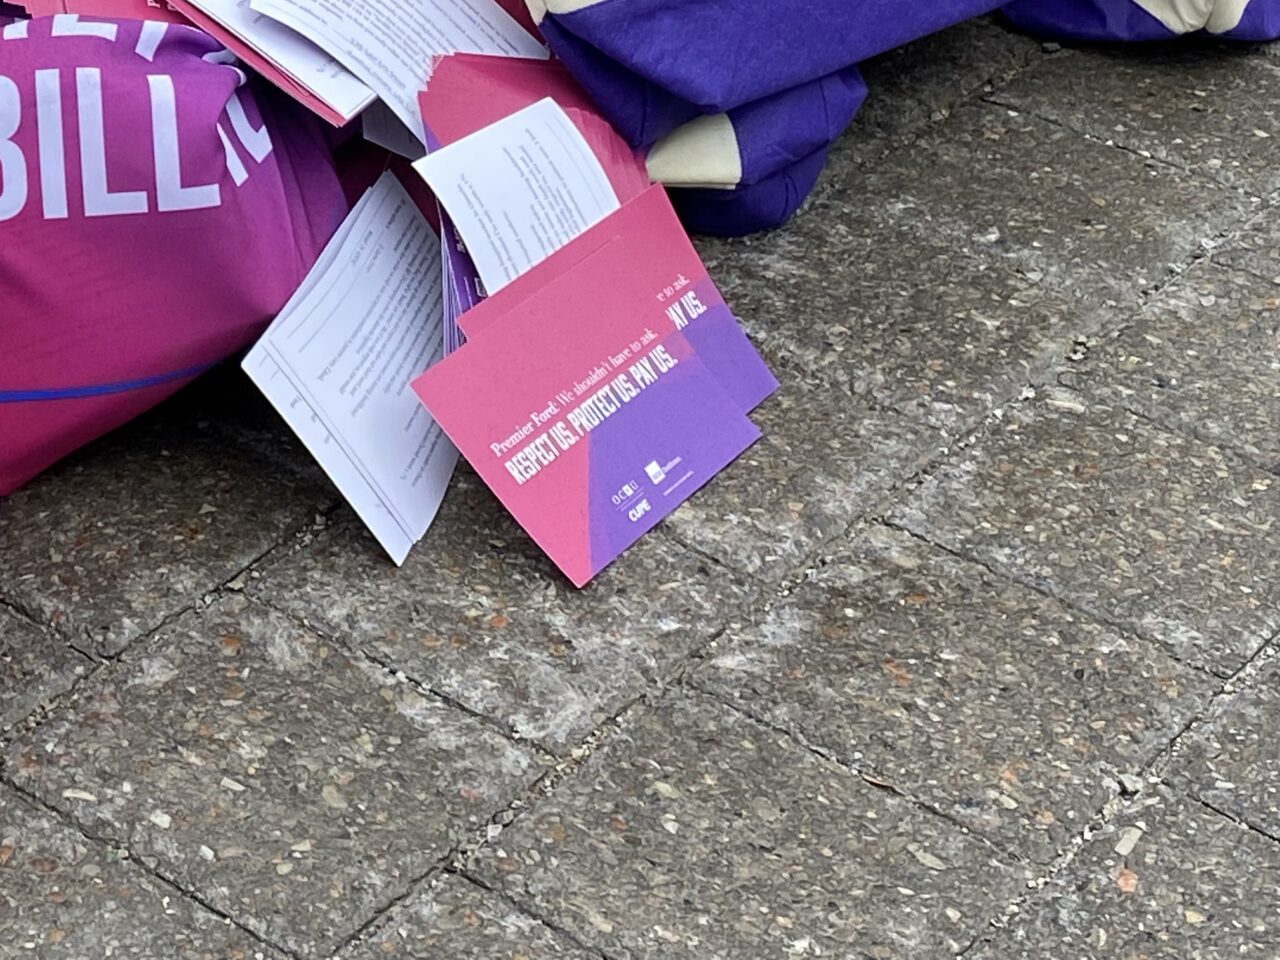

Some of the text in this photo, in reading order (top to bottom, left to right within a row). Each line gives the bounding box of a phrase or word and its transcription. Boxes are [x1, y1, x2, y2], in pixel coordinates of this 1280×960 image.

[666, 291, 706, 330] AY US.
[490, 422, 534, 457] Premier
[530, 401, 560, 426] Ford:
[555, 390, 574, 406] We
[573, 362, 612, 396] shouldn't
[608, 349, 632, 368] have
[629, 341, 641, 352] to
[504, 345, 678, 484] RESPECT US. PROTECT US. PAY US.
[629, 499, 650, 521] CUPE
